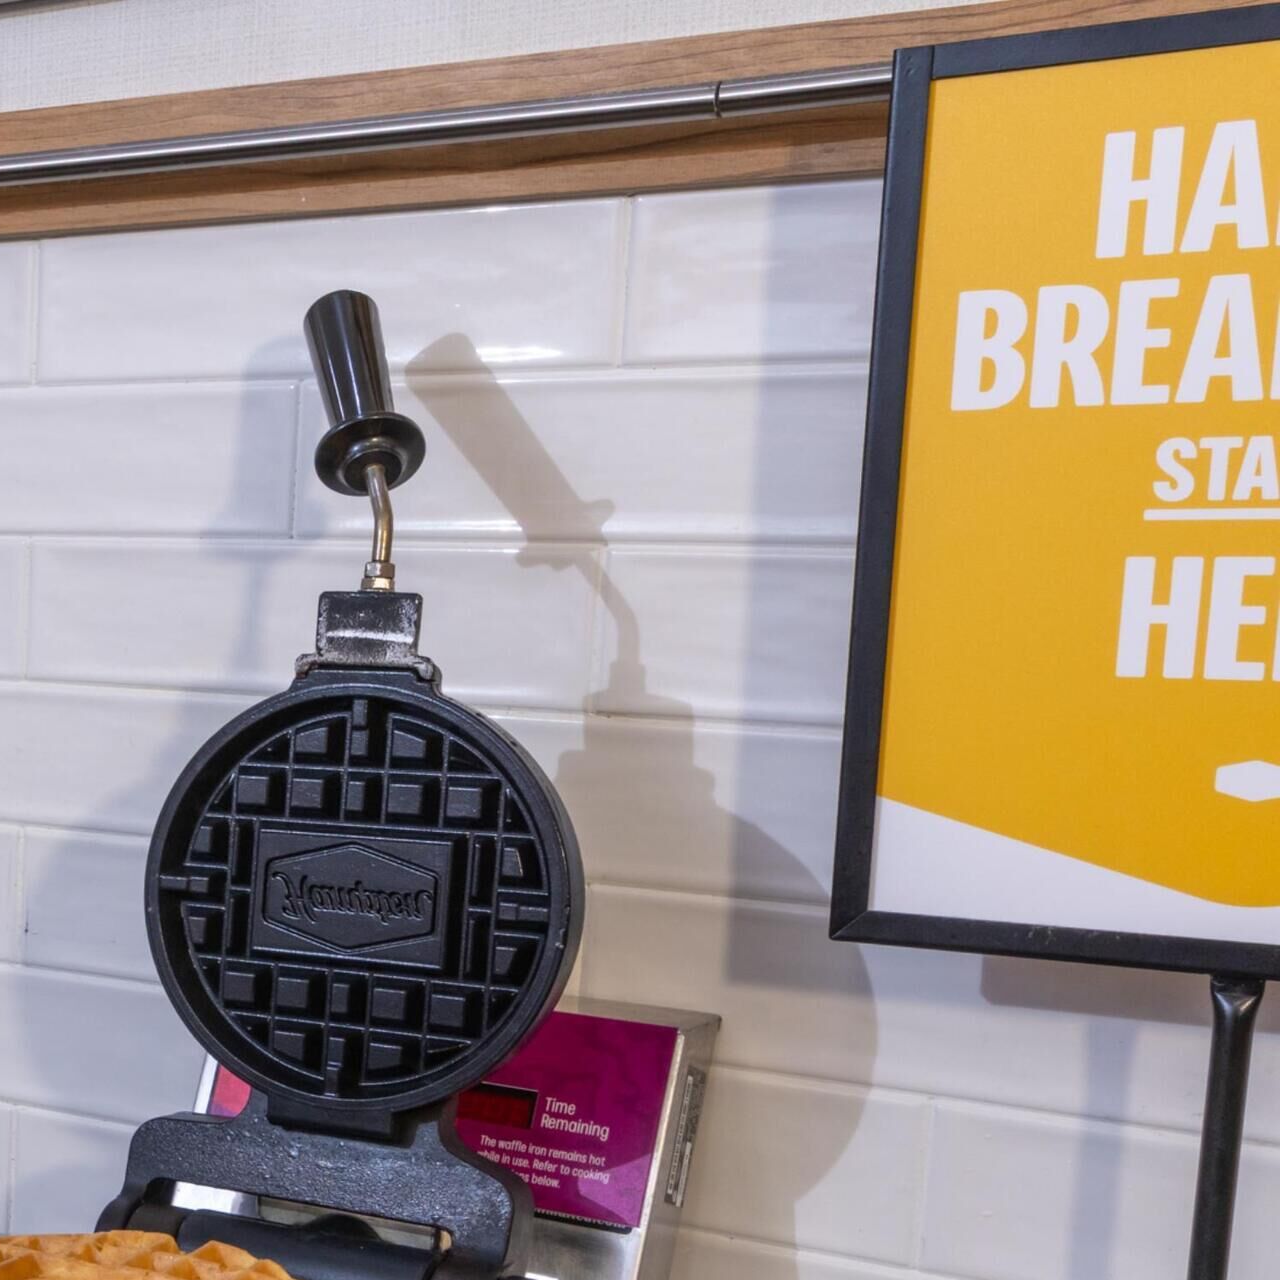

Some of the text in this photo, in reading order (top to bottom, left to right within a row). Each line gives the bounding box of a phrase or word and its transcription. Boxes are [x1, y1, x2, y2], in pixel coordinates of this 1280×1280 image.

[1096, 119, 1280, 259] HA
[950, 273, 1280, 412] BREA
[1115, 555, 1280, 682] HE
[544, 1096, 576, 1116] Time
[540, 1113, 610, 1142] Remaining
[480, 1134, 606, 1167] The waffle iron remains hot
[501, 1153, 610, 1185] in use. Refer to cooking
[531, 1172, 561, 1189] below.
